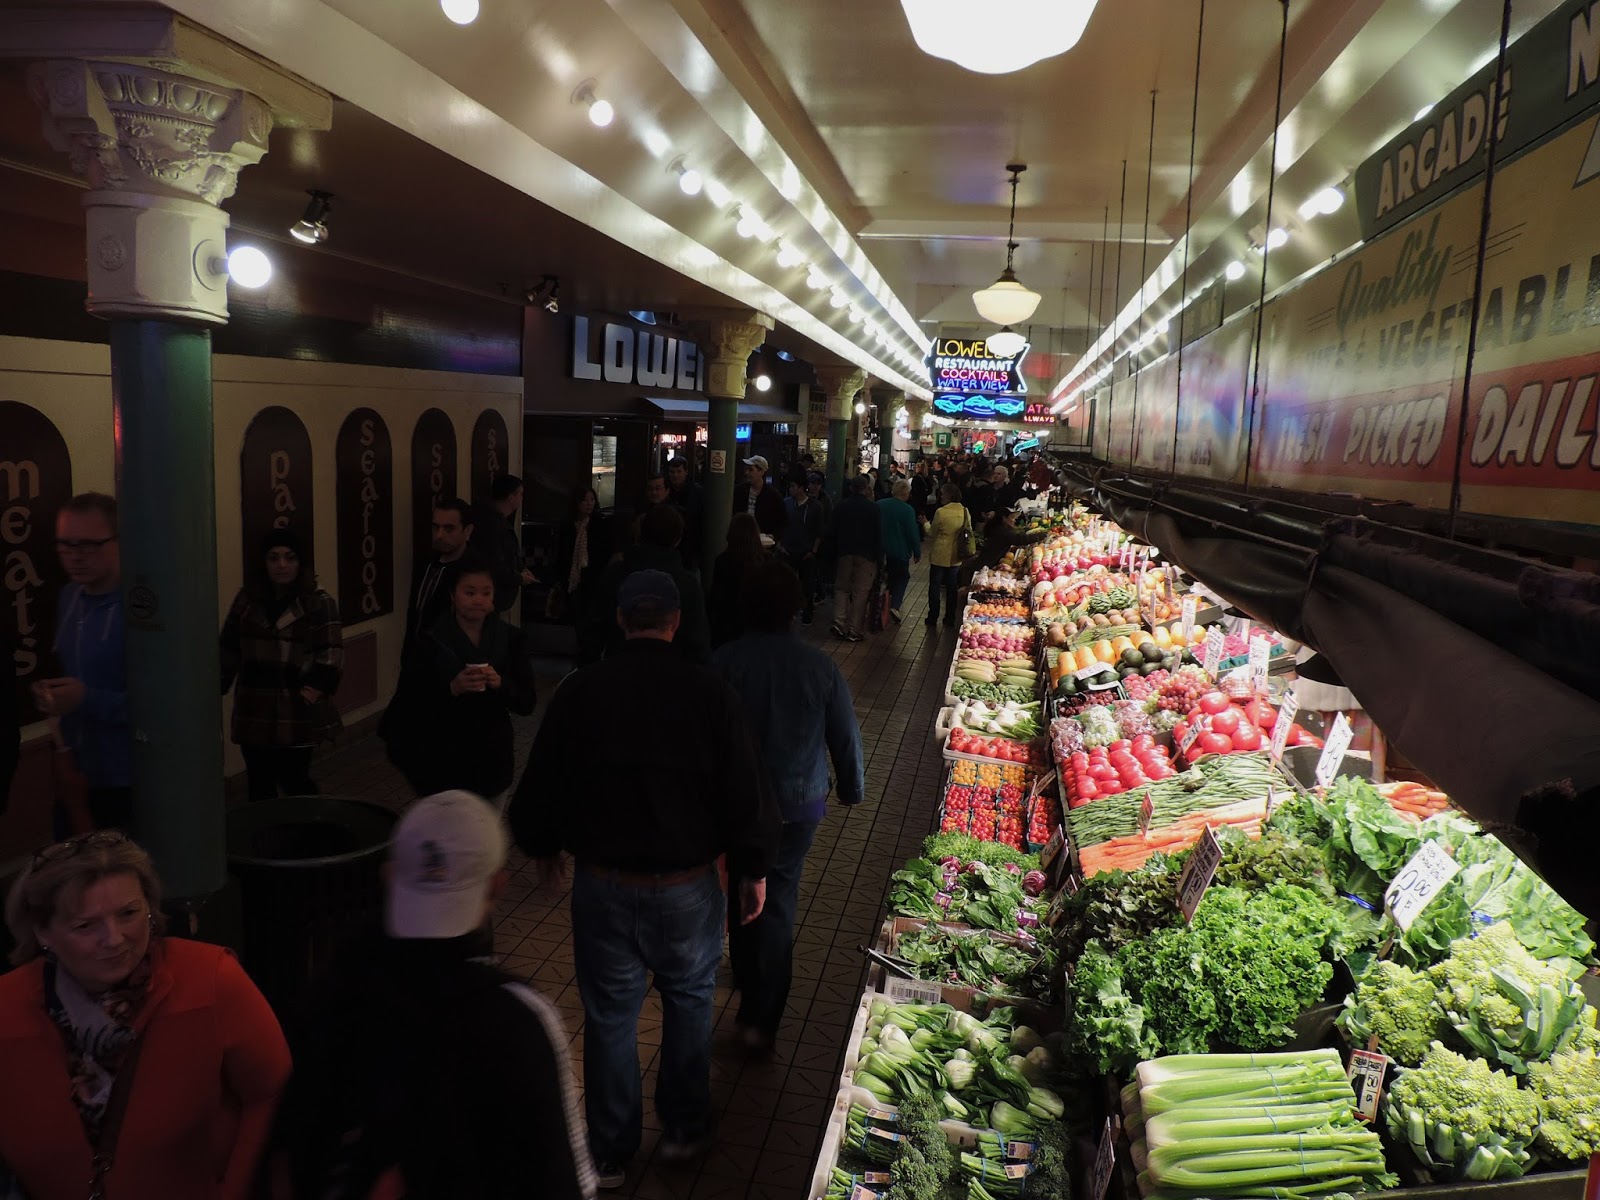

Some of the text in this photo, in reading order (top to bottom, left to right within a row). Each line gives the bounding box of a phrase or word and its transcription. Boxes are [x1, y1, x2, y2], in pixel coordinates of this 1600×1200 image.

[1375, 67, 1512, 221] ARCADE
[1336, 211, 1453, 334] Quality
[572, 314, 704, 392] LOWE
[935, 356, 1014, 372] RESTAURANT
[936, 338, 1017, 360] LOWEL
[937, 377, 1010, 391] WATER VIEW
[940, 368, 1009, 382] COCKTAILS
[1342, 392, 1448, 468] PICKED
